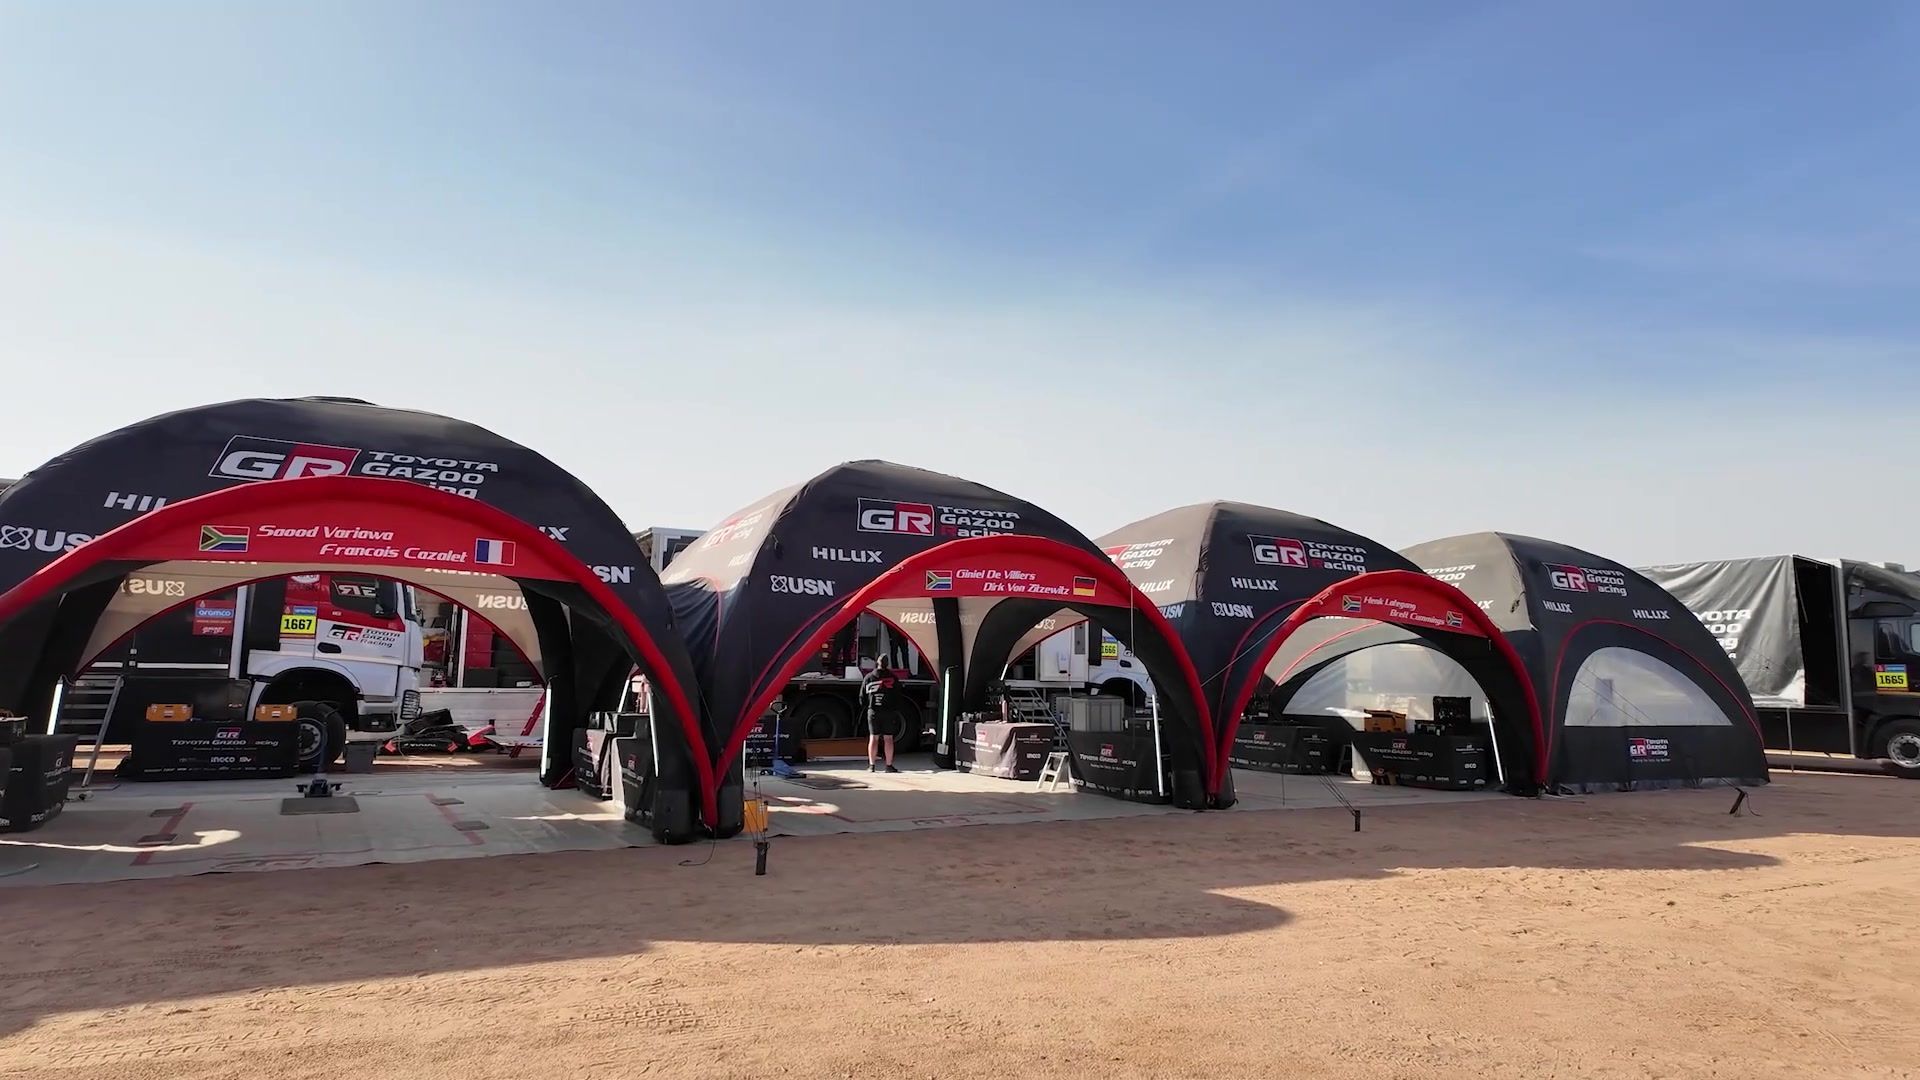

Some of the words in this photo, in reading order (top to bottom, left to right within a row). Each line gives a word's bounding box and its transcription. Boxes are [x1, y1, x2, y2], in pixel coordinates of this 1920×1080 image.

[220, 450, 347, 480] GR
[368, 451, 499, 472] TOYOTA
[361, 462, 485, 484] GAZOO
[937, 506, 1020, 519] TOYOTA
[861, 509, 932, 533] GR
[940, 513, 1015, 529] GAZOO
[256, 525, 320, 538] Saood
[323, 526, 394, 541] Variawa
[35, 529, 100, 553] US
[1129, 539, 1174, 551] TOYOTA
[1303, 541, 1367, 554] TOYOTA
[320, 543, 400, 558] Francois
[404, 547, 468, 563] Cazalet
[812, 546, 883, 563] HILUX
[1121, 548, 1163, 560] GAZOO
[1254, 544, 1305, 565] GR
[1308, 549, 1365, 563] GAZOO
[588, 565, 631, 583] SN
[986, 570, 1002, 579] De
[1004, 570, 1037, 581] Villiers
[1551, 571, 1586, 590] GR
[1586, 574, 1625, 585] GAZOO
[788, 576, 834, 596] USN
[983, 582, 1005, 592] Dirk
[1007, 583, 1026, 593] Von
[1138, 579, 1175, 593] HILUX
[1230, 576, 1279, 591] HILUX
[1162, 604, 1185, 619] USN
[1223, 603, 1255, 619] USN
[1542, 600, 1573, 613] HILUX
[1632, 609, 1671, 619] HILUX
[1692, 609, 1752, 621] YOTA
[284, 618, 312, 630] 1667
[329, 629, 361, 640] GR
[217, 731, 240, 739] GR
[1630, 745, 1647, 755] GR
